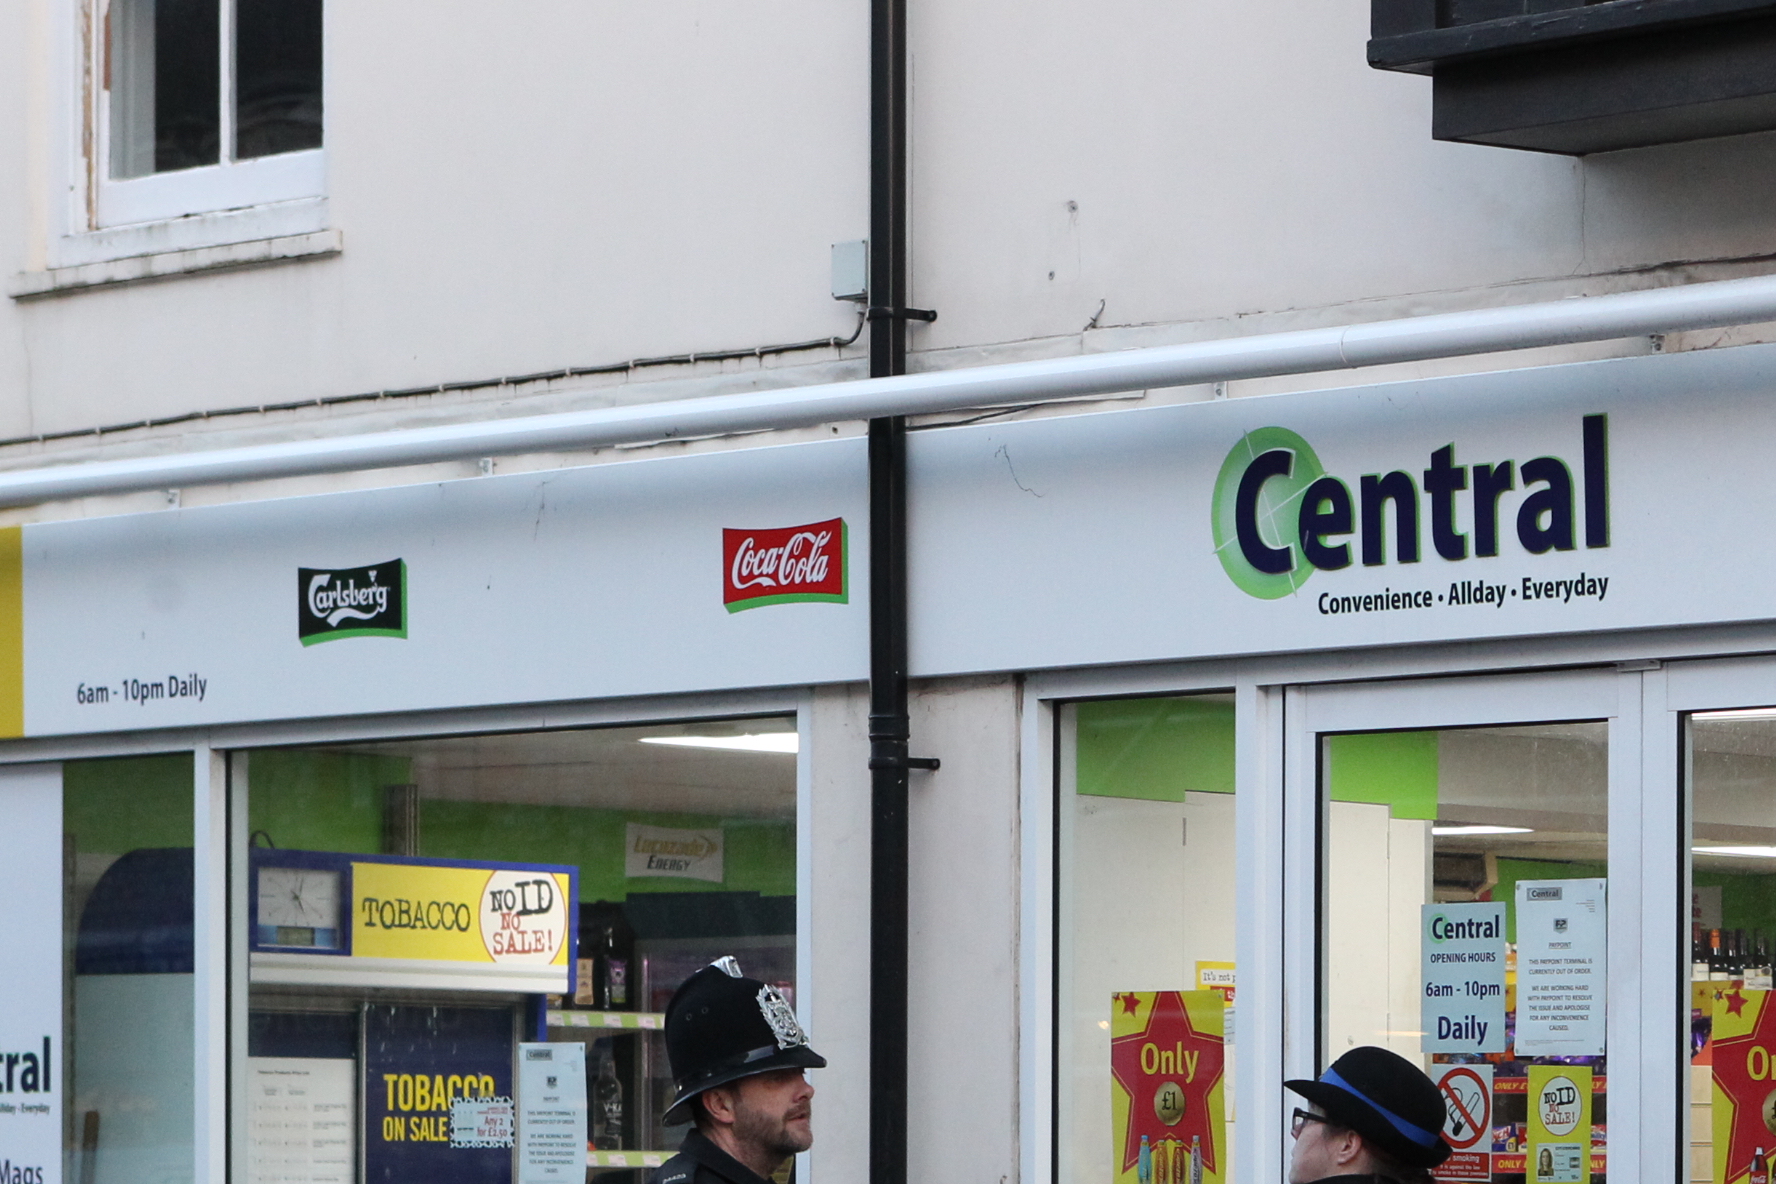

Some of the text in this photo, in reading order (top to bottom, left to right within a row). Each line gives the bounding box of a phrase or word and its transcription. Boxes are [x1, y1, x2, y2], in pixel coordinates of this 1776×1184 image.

[1235, 412, 1612, 575] Central
[308, 570, 390, 628] Carlsberg
[1318, 572, 1609, 616] Convenience Allday Everyday
[77, 673, 208, 706] 6am 10pm Daily
[489, 879, 554, 916] NO ID
[1531, 890, 1559, 898] Central
[362, 897, 471, 933] TOBACCO
[500, 911, 522, 931] NO
[1432, 914, 1500, 940] Central
[492, 930, 553, 955] SALE!
[1430, 951, 1496, 964] OPENING HOURS
[1425, 981, 1500, 1000] 6am 10pm
[1438, 1016, 1488, 1046] Daily
[1140, 1041, 1200, 1084] Only
[1162, 1090, 1177, 1111] £1
[1543, 1091, 1557, 1105] NO
[1556, 1086, 1576, 1106] ID
[383, 1116, 448, 1141] ON SALE
[1545, 1111, 1575, 1125] SALE!
[1453, 1154, 1480, 1163] smoking
[1498, 1160, 1521, 1168] ONLY
